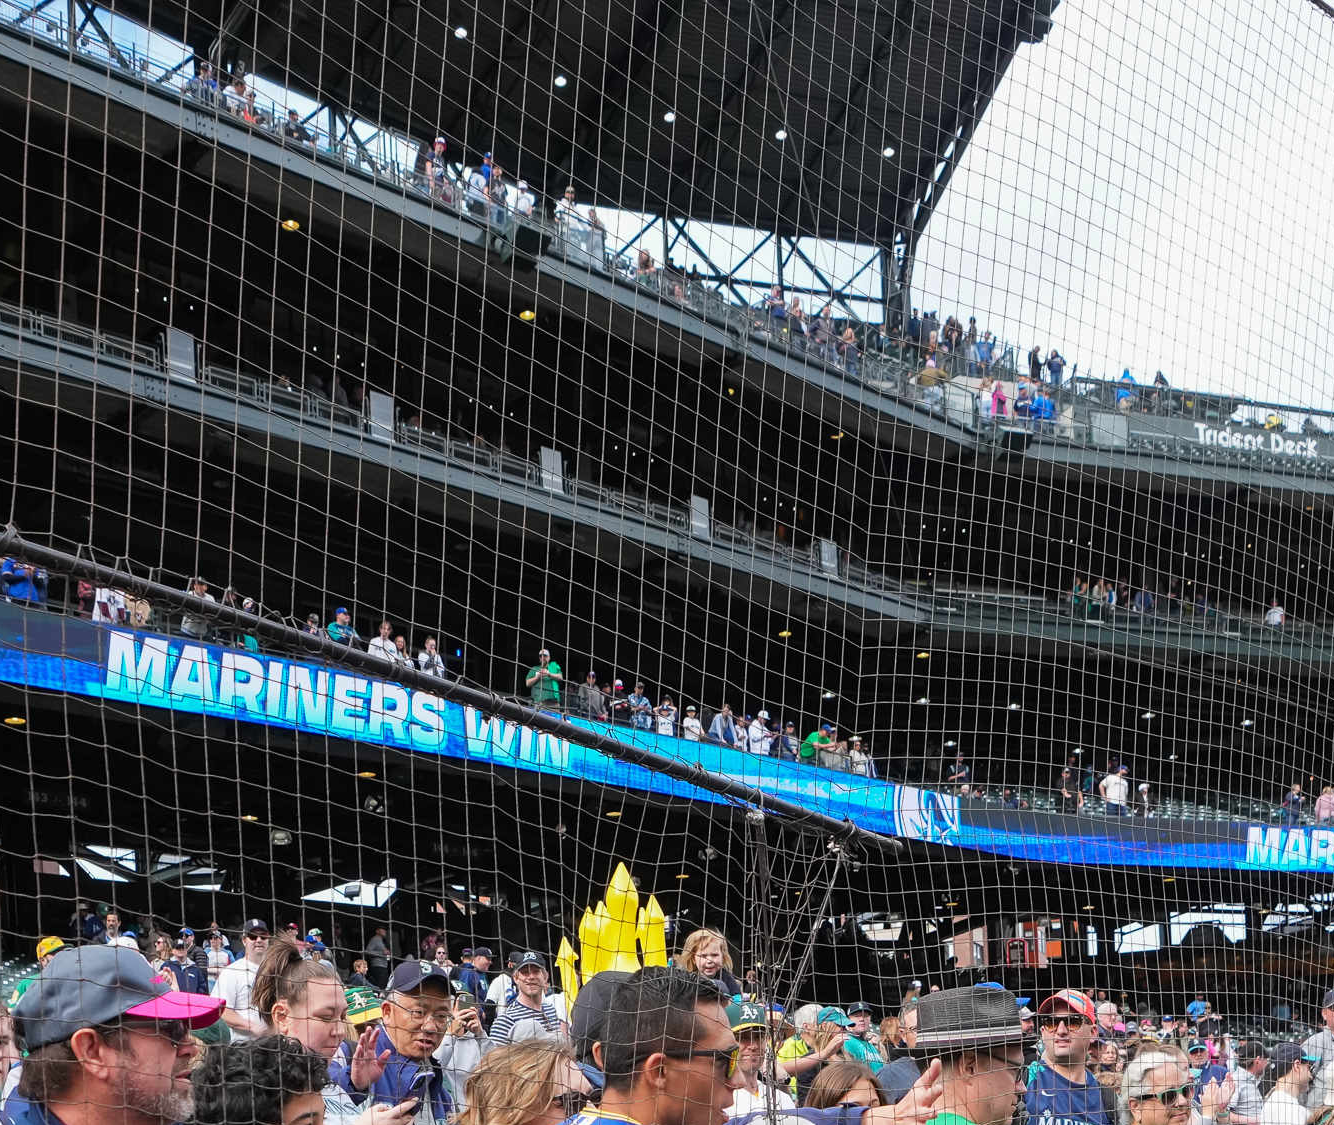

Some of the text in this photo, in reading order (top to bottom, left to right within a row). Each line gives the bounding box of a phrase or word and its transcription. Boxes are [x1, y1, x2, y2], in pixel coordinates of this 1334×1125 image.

[1193, 421, 1317, 458] Trident Deck
[106, 632, 571, 768] MARINERS WIN
